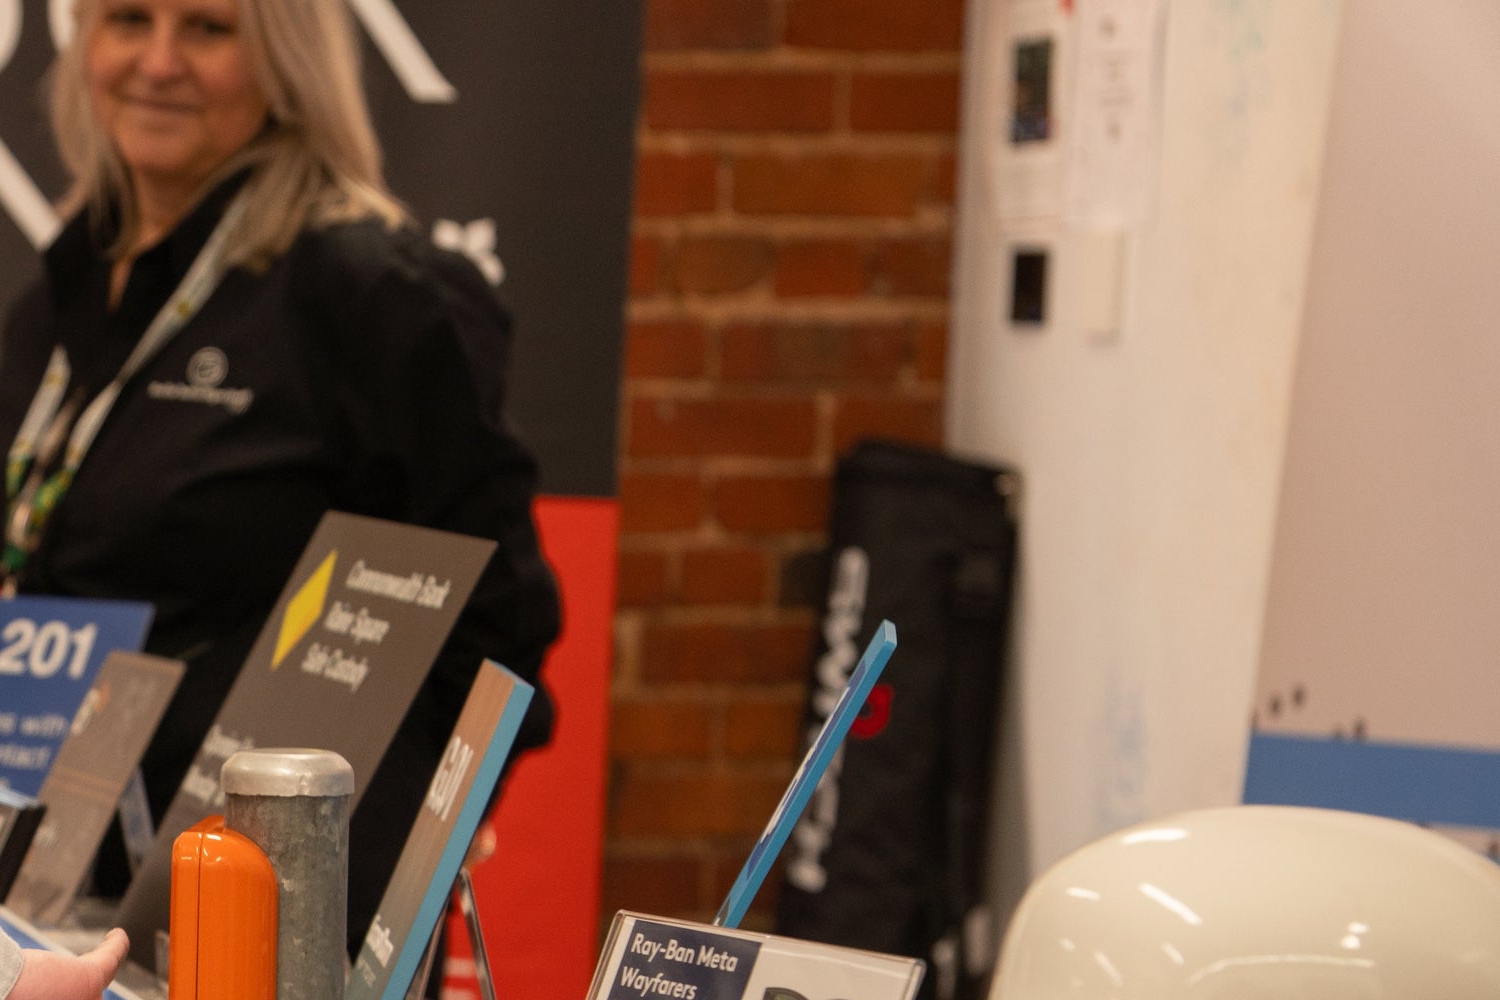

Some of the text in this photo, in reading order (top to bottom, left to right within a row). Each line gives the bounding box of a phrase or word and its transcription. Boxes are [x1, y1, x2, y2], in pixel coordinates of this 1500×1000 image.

[346, 558, 451, 610] Commonwealth Bank
[631, 933, 738, 972] Ray-Ban Meta
[620, 966, 698, 1000] Wayfarers
